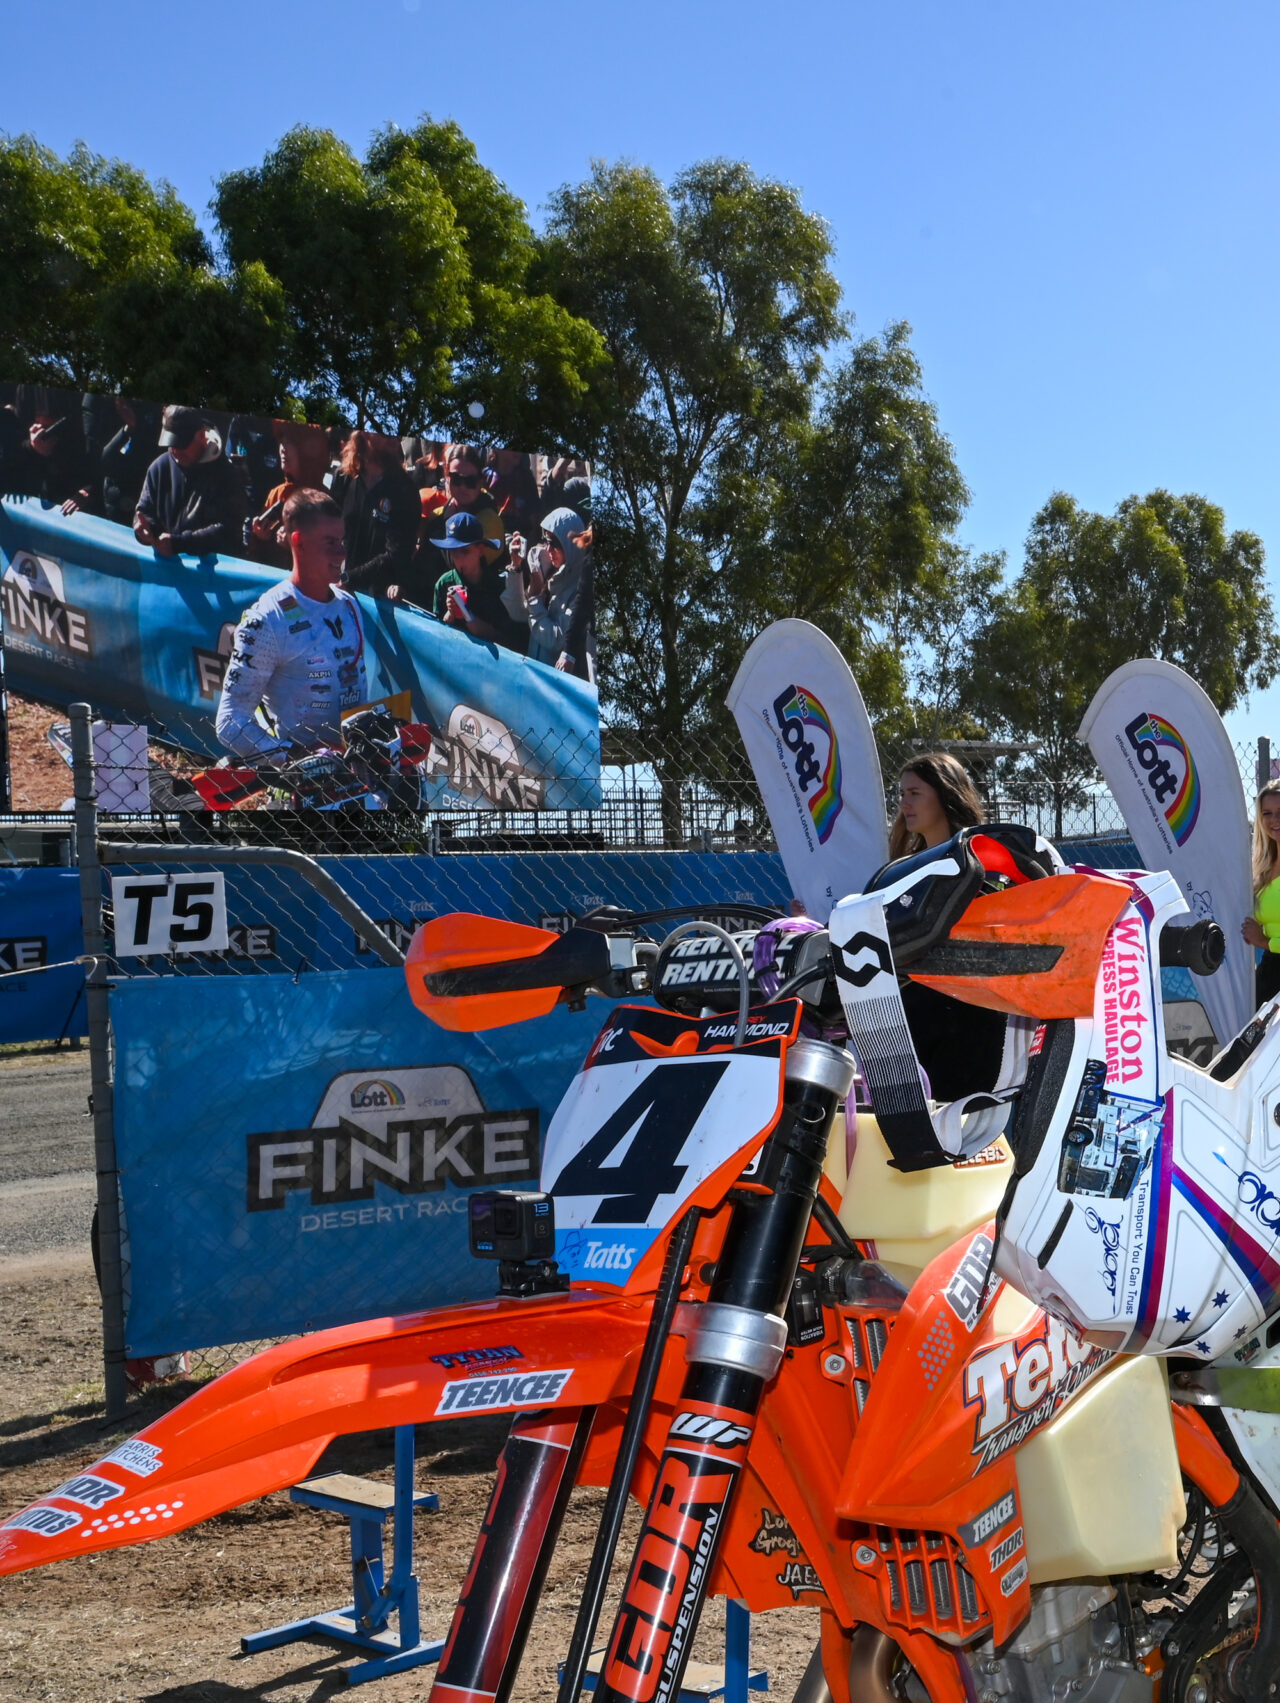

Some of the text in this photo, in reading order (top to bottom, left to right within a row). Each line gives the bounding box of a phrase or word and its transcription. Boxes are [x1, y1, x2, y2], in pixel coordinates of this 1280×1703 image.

[773, 684, 822, 793] Lott
[1150, 720, 1161, 739] the
[1125, 712, 1178, 804] Lott
[1115, 734, 1129, 759] Official
[1127, 758, 1138, 779] Home
[1141, 787, 1159, 823] Australia's
[1157, 822, 1173, 855] Lotteries
[800, 814, 815, 853] Lotteries
[124, 882, 215, 946] T5
[0, 982, 27, 993] ACE
[1113, 916, 1149, 1085] Winston
[1104, 997, 1120, 1084] HAULAGE
[351, 1091, 388, 1108] Lott
[258, 1119, 530, 1200] FINKE
[550, 1060, 732, 1224] 4
[301, 1196, 470, 1233] DESERT RAC
[534, 1202, 549, 1213] 13
[584, 1240, 638, 1270] Tatts
[1126, 1180, 1150, 1315] Transport You Can Trust
[429, 1345, 524, 1369] TYTAN
[440, 1373, 568, 1411] TEENCEE
[669, 1411, 754, 1445] WP
[972, 1493, 1014, 1543] TEENCEE
[990, 1529, 1023, 1569] THOR
[604, 1456, 734, 1703] GDR
